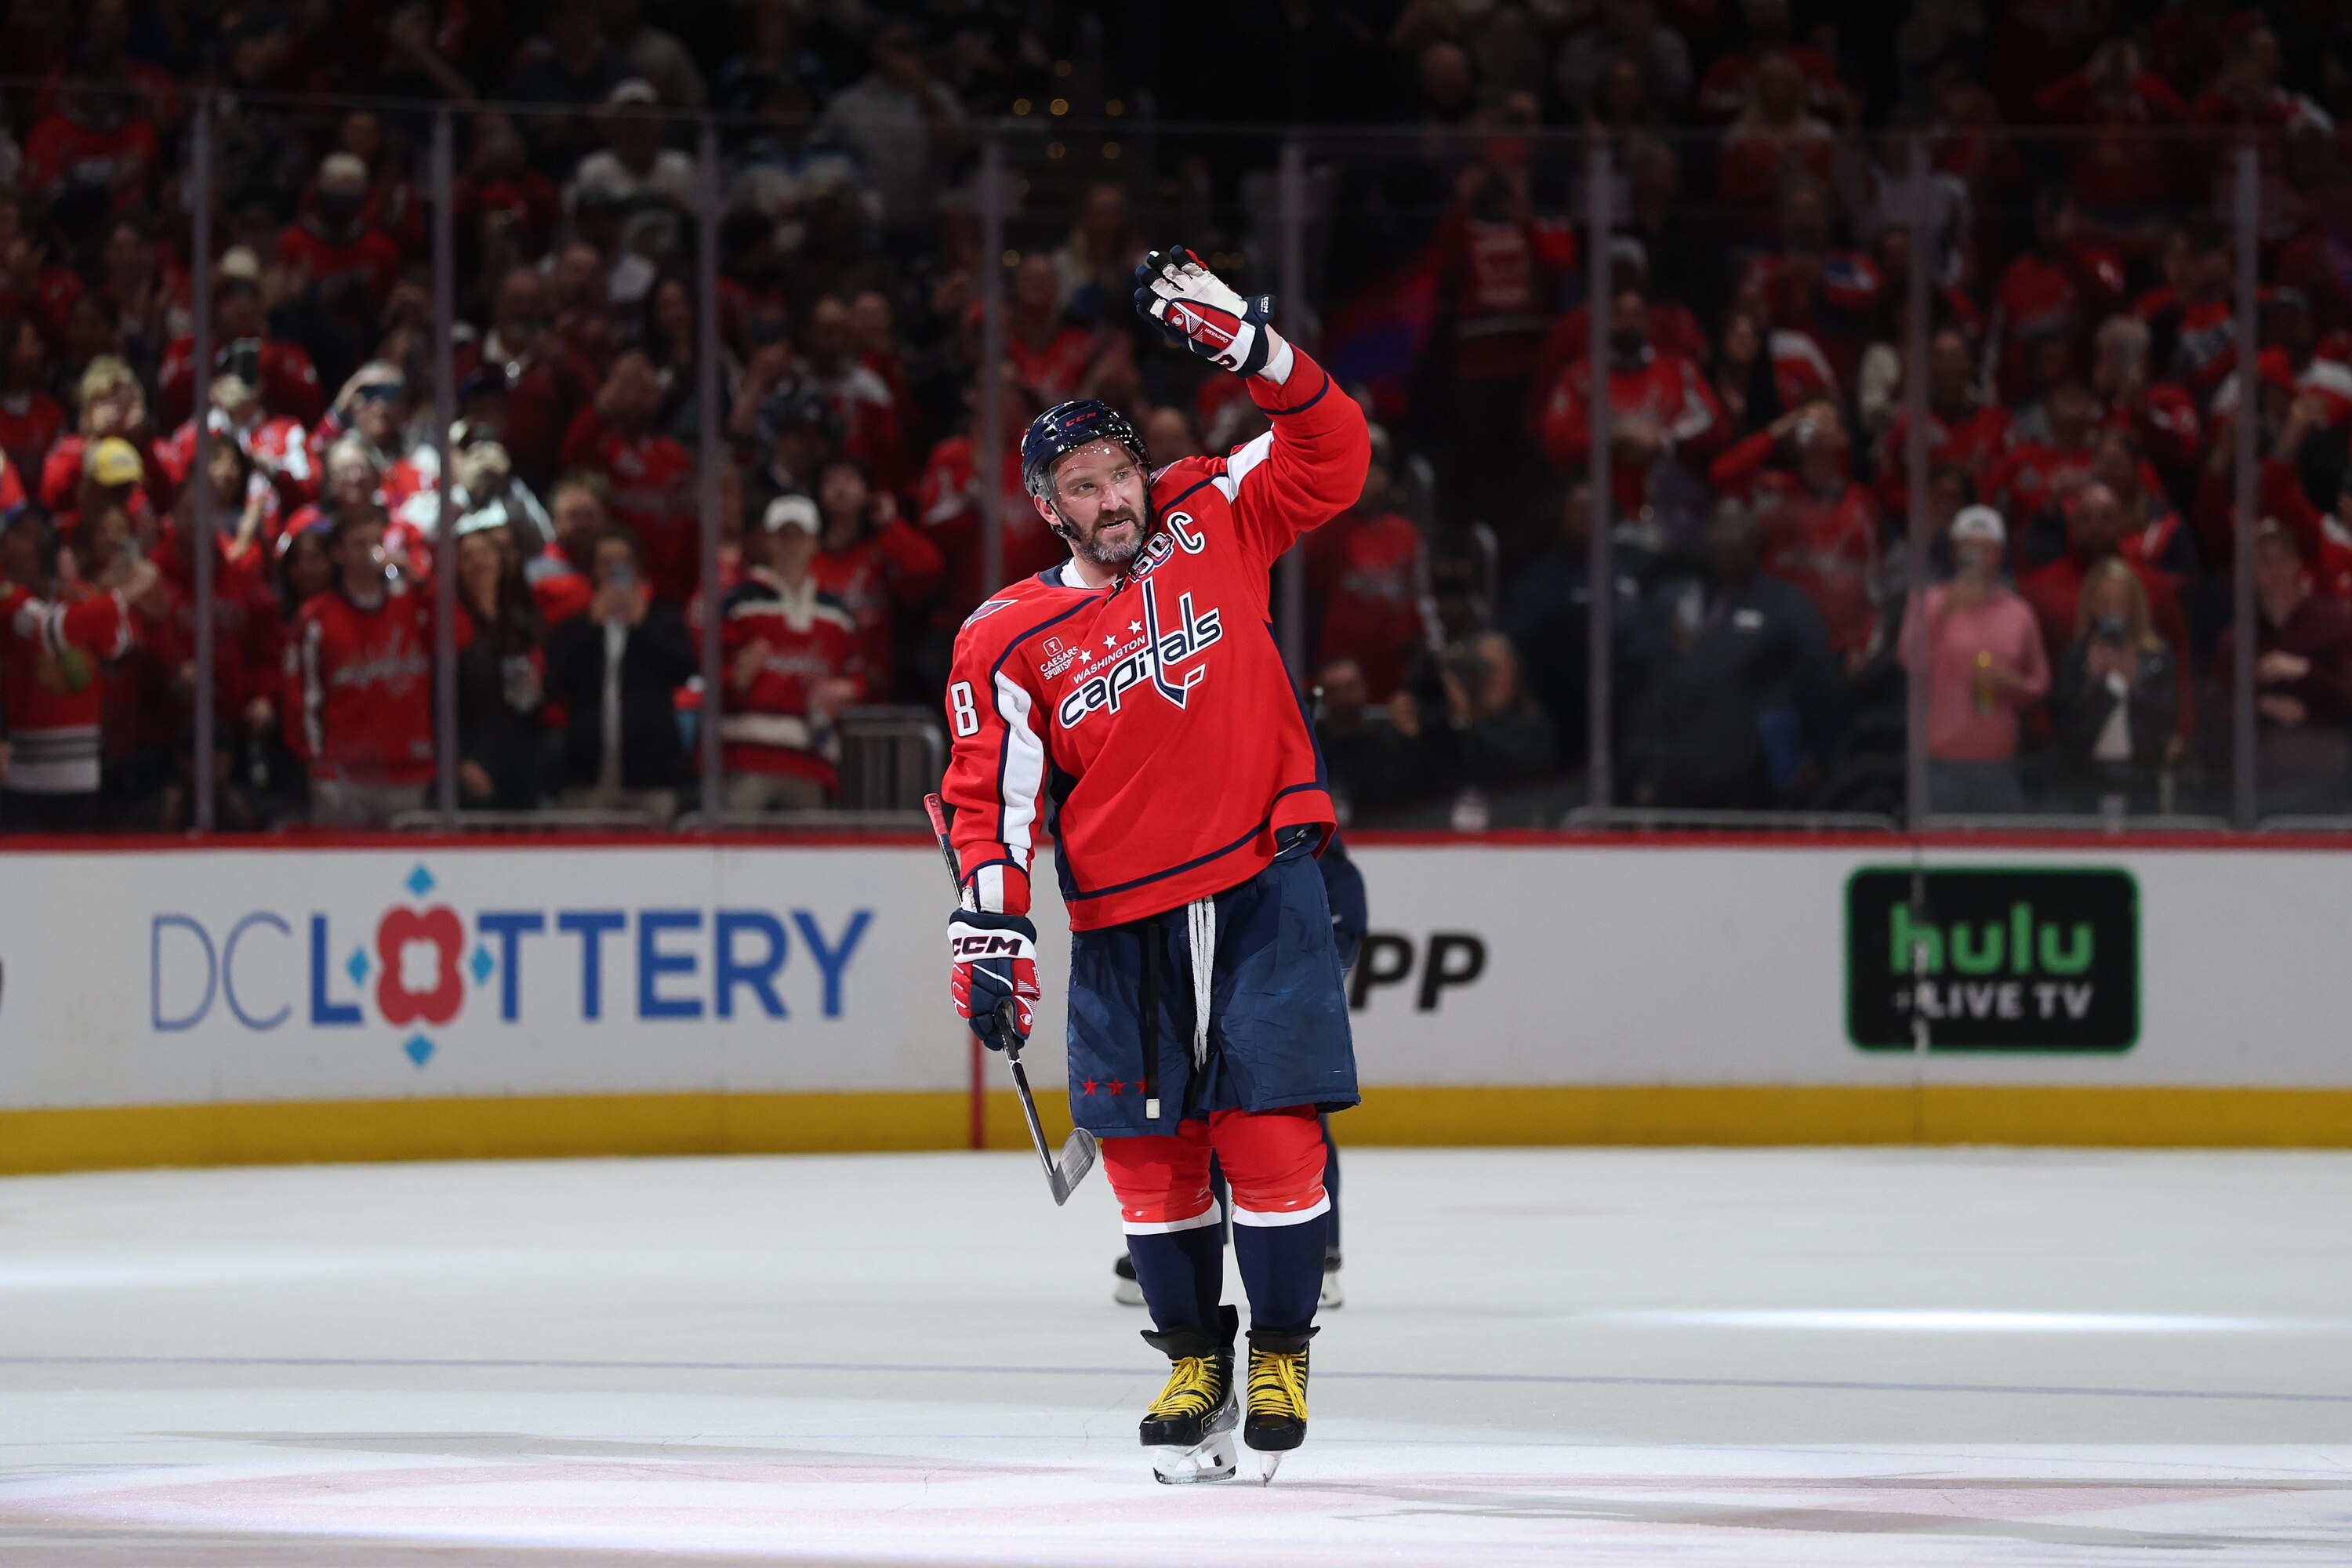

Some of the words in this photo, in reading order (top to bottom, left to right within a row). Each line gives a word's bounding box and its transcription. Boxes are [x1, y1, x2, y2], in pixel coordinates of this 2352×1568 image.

[1065, 411, 1097, 427] CCM
[1129, 533, 1174, 578] 50
[1167, 511, 1206, 555] C
[1040, 645, 1080, 673] CAESARS
[1073, 635, 1146, 684] WASHINGTON
[949, 680, 979, 738] 8
[1888, 899, 2096, 976] hulu
[1348, 930, 1487, 1012] PP
[2031, 981, 2095, 1020] TV
